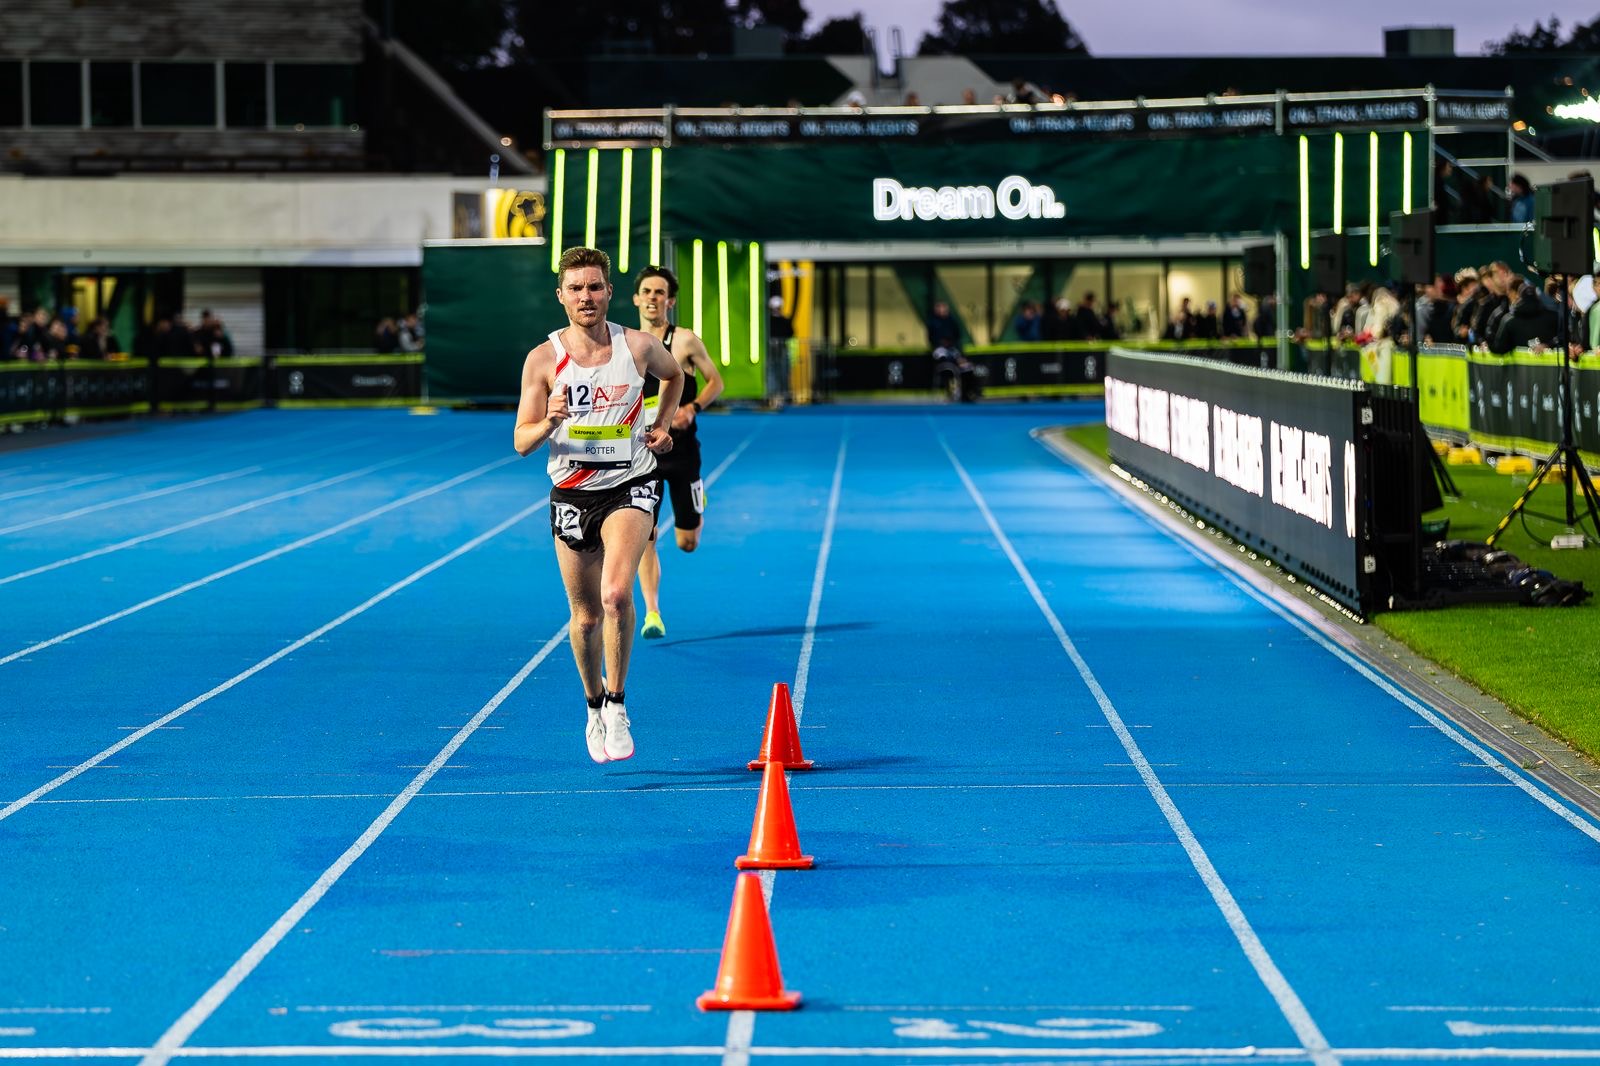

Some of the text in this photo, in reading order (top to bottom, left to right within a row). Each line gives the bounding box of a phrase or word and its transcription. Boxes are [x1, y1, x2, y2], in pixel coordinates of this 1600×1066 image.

[873, 174, 1066, 221] Dream On.
[567, 384, 590, 407] 12
[585, 446, 616, 455] POTTER
[557, 506, 579, 531] 12
